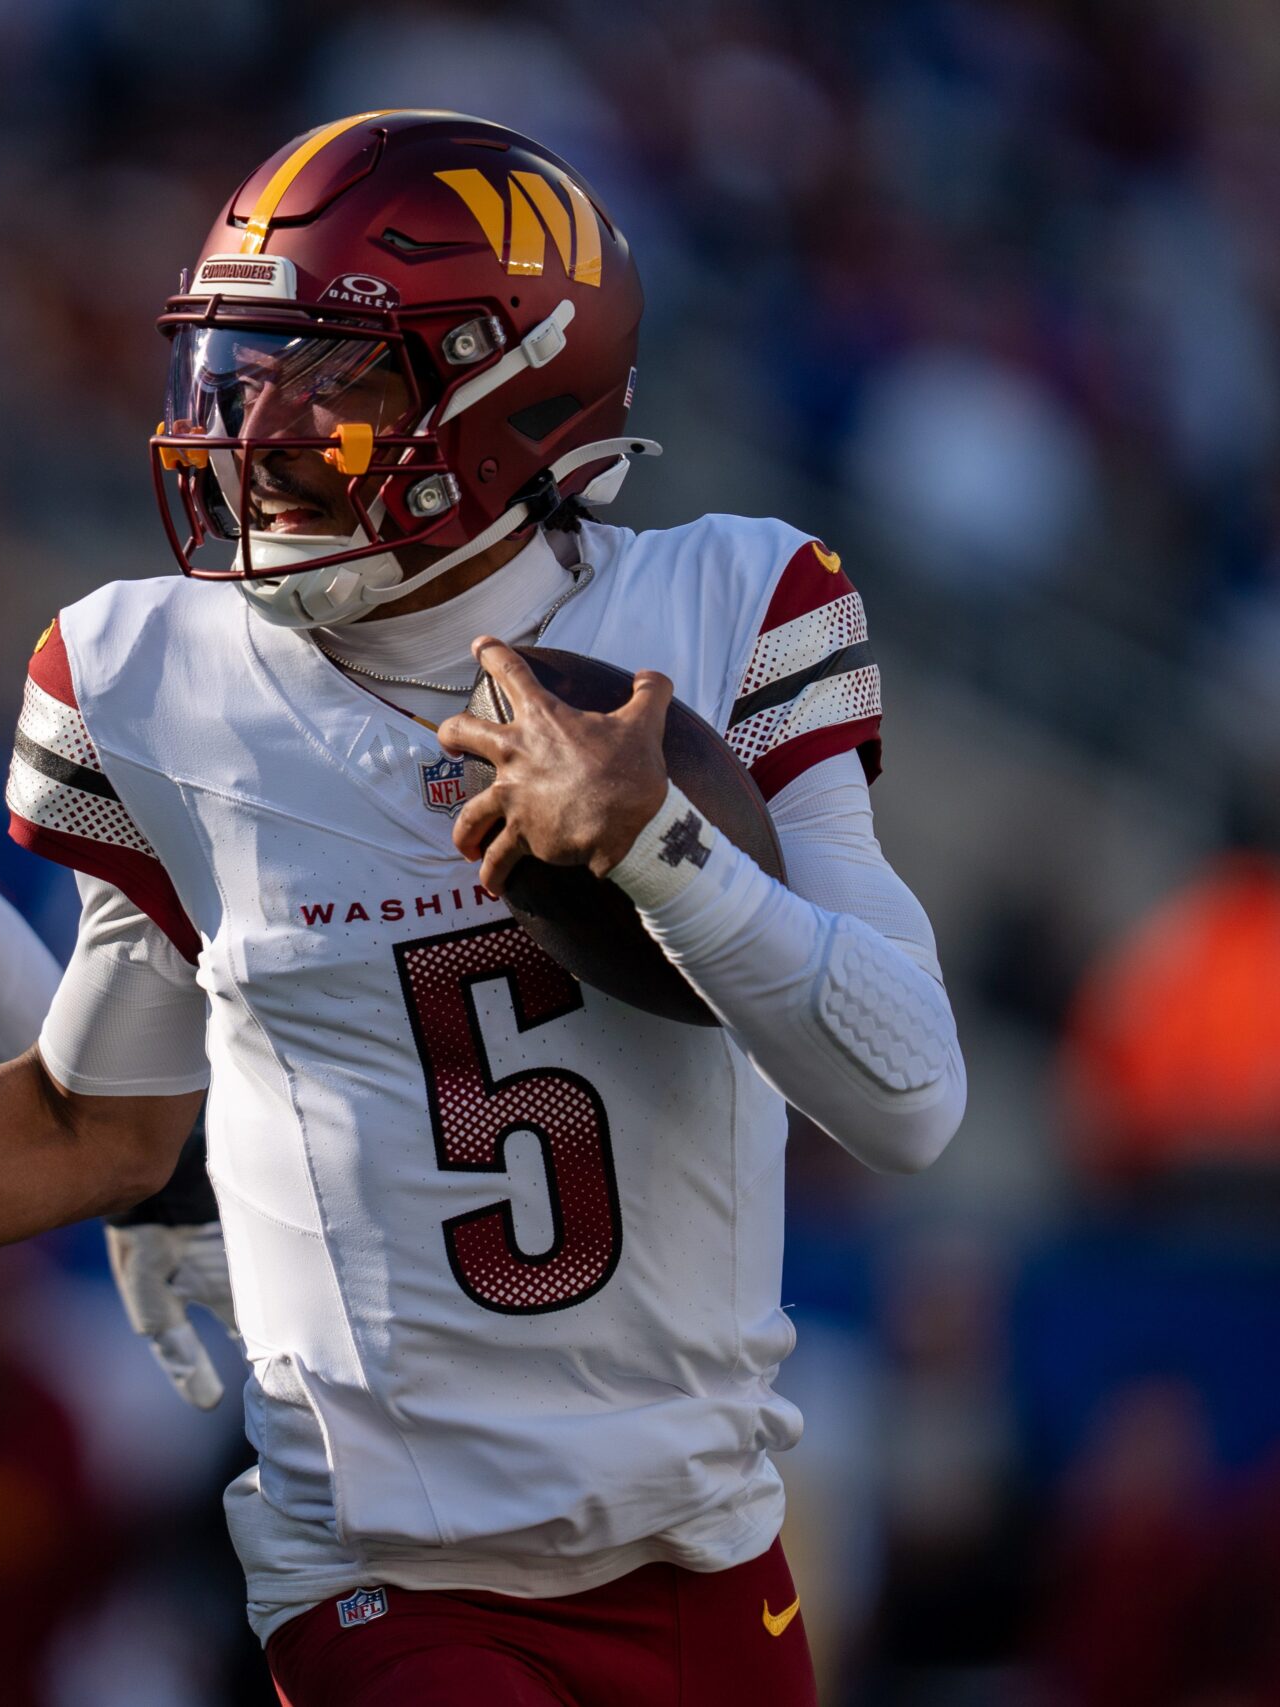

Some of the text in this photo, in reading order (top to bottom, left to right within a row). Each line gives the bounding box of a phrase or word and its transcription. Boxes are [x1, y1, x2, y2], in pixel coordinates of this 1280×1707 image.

[201, 263, 274, 280] COMMANDERS
[328, 288, 395, 310] OAKLEY
[429, 779, 467, 804] NFL
[392, 916, 623, 1316] 5
[346, 1601, 381, 1622] NFL
